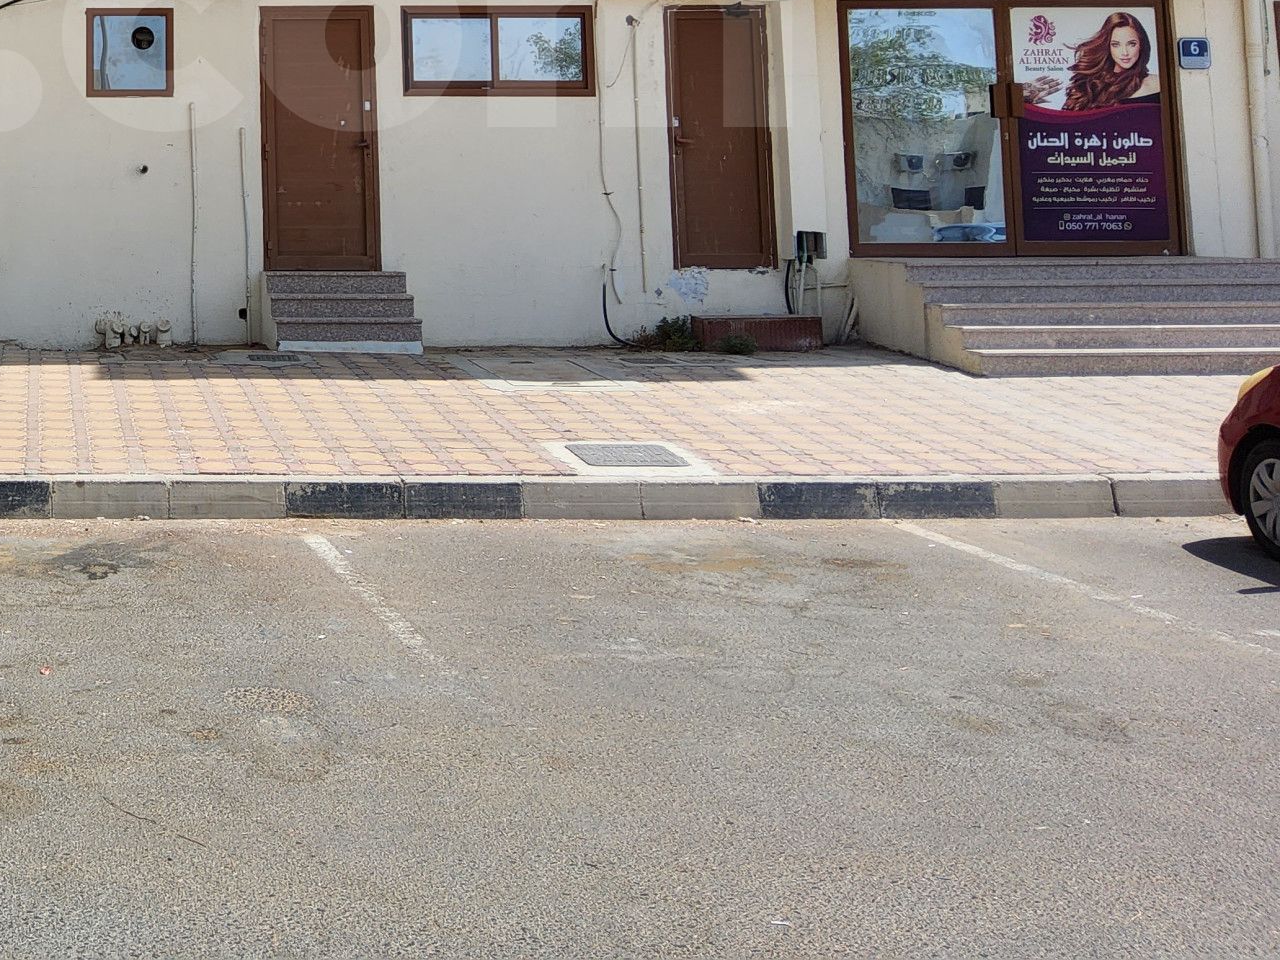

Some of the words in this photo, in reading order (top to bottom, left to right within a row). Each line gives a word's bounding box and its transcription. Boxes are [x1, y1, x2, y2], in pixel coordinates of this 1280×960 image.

[1023, 48, 1064, 56] ZAHRAT
[1190, 41, 1200, 55] 6
[1019, 57, 1032, 65] AL
[1034, 57, 1069, 65] HANAN
[1025, 65, 1045, 73] Beauty
[1027, 131, 1069, 150] الحنان
[1074, 131, 1107, 150] زهرة
[1112, 131, 1153, 150] صالون
[1047, 151, 1094, 166] السيدات
[1099, 152, 1137, 166] لتجميل
[1065, 222, 1083, 230] 050
[1085, 222, 1099, 230] 771
[1100, 222, 1123, 230] 7063
